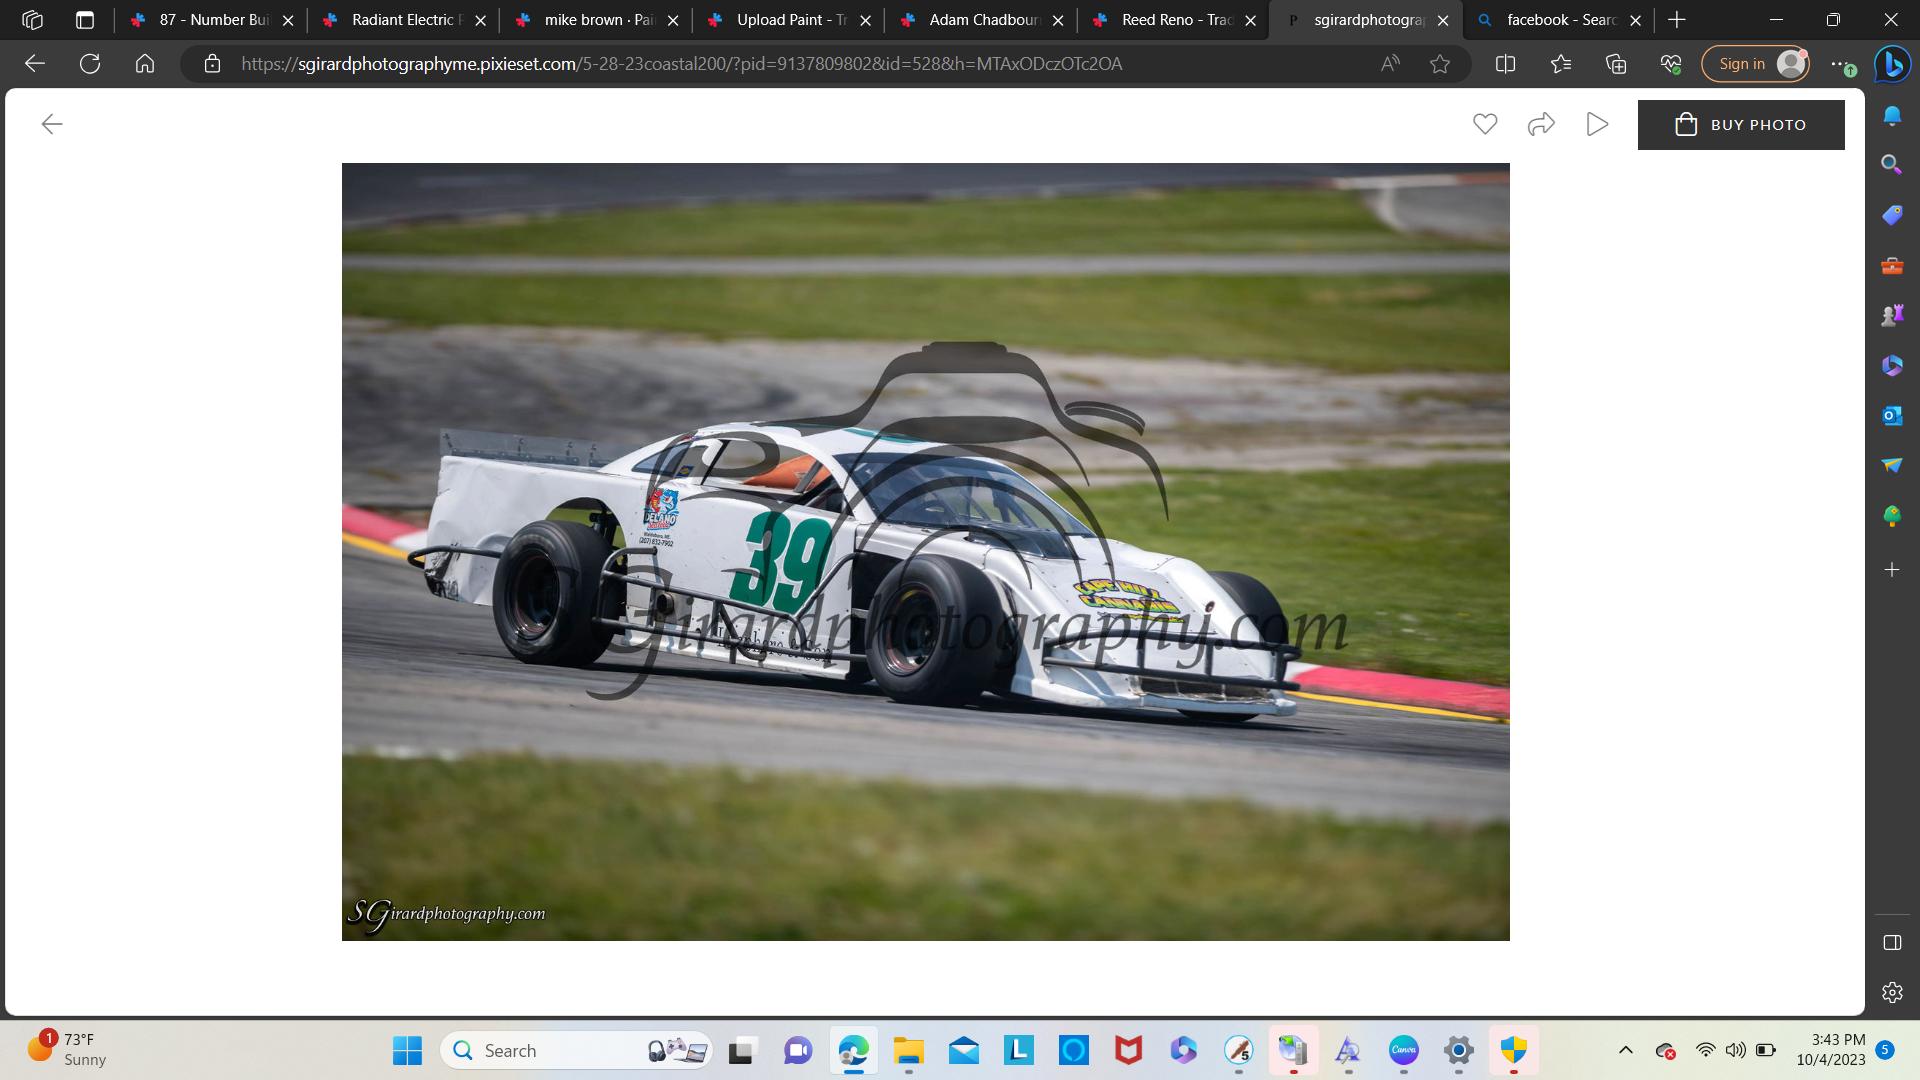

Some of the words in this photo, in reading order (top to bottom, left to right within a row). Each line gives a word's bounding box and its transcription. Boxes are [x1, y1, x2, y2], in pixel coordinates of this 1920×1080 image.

[159, 13, 177, 27] 87
[190, 13, 246, 27] Number
[352, 12, 404, 27] Radiant
[407, 12, 455, 27] Electric
[544, 12, 578, 27] mike
[581, 12, 623, 27] brown
[737, 12, 786, 29] Upload
[789, 12, 823, 27] Paint
[928, 12, 969, 27] Adam
[1122, 12, 1156, 27] Reed
[1160, 13, 1194, 27] Reno
[1507, 12, 1570, 27] facebook
[1719, 56, 1749, 73] Sign
[1753, 57, 1766, 71] in
[1711, 119, 1745, 131] BUY
[1750, 119, 1807, 131] PHOTO
[728, 511, 833, 616] 39
[64, 1033, 95, 1046] 73°F
[1812, 1033, 1840, 1046] 3:43
[1844, 1033, 1866, 1046] PM
[485, 1043, 538, 1058] Search
[1391, 1044, 1417, 1054] Canva
[1881, 1044, 1890, 1056] 5
[64, 1053, 107, 1069] Sunny
[1797, 1053, 1866, 1067] 10/4/2023
